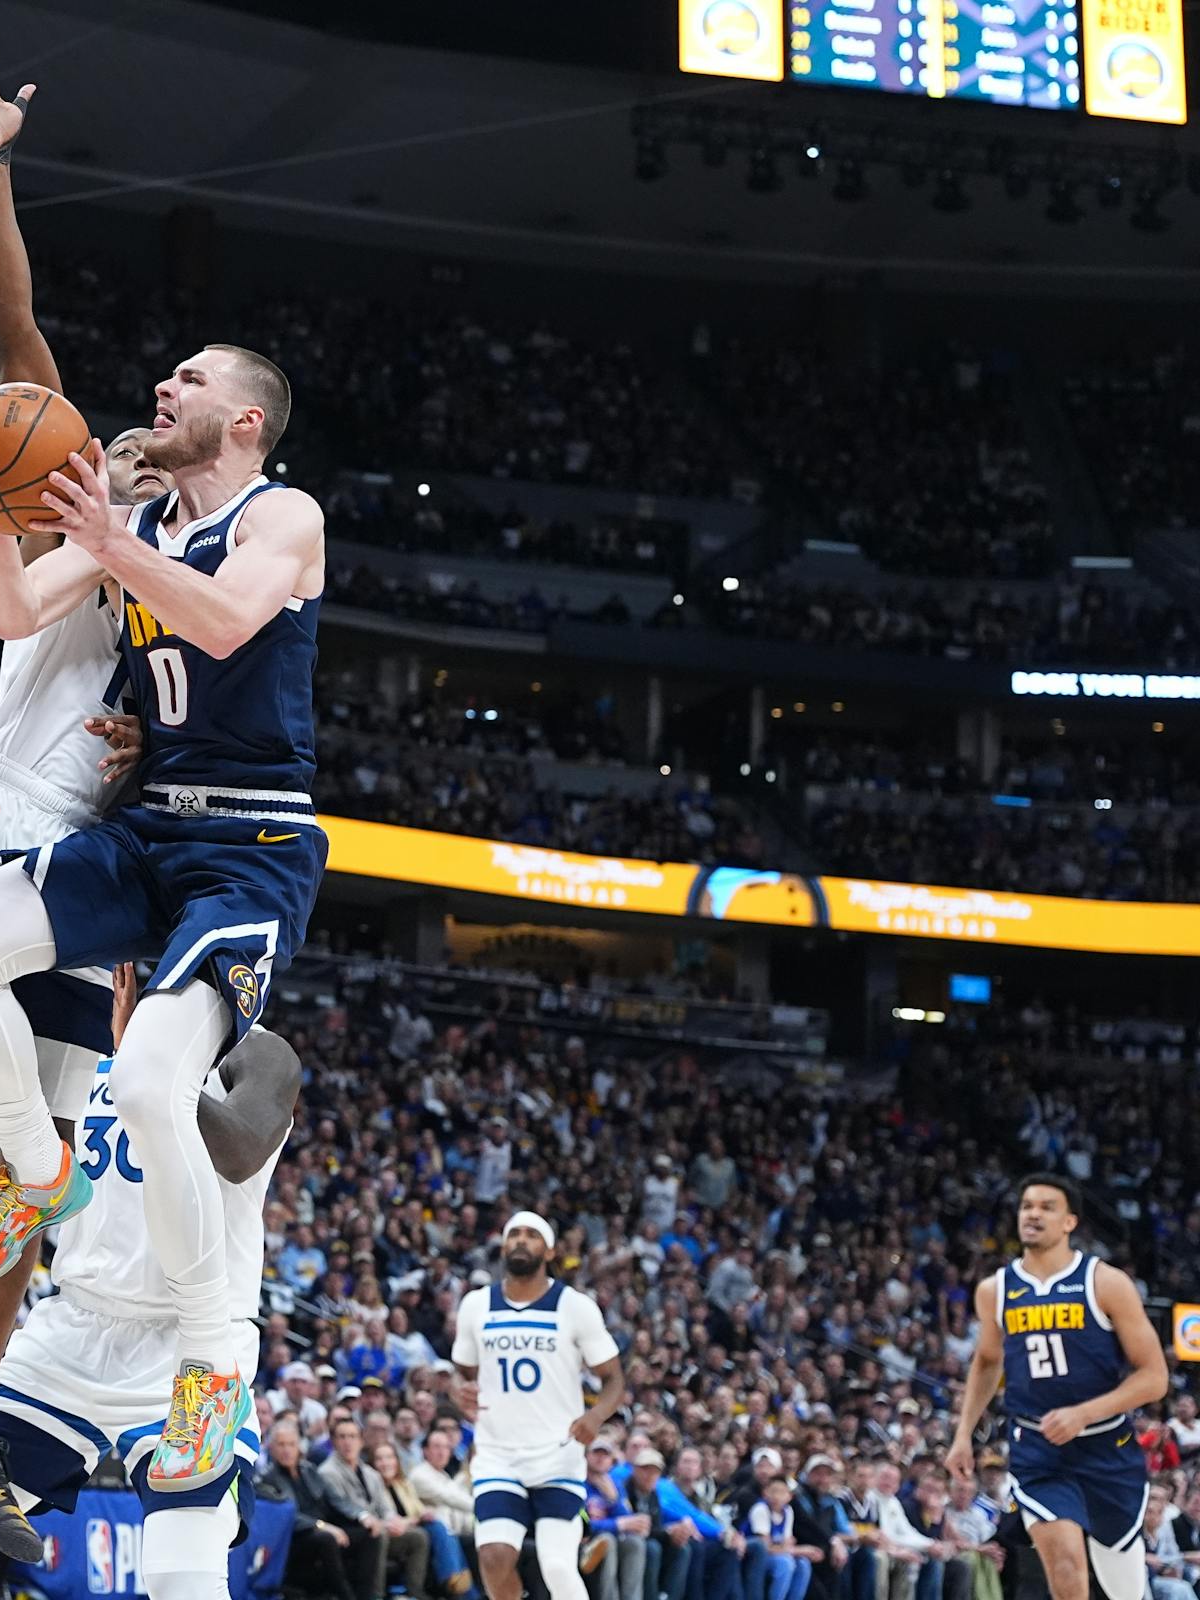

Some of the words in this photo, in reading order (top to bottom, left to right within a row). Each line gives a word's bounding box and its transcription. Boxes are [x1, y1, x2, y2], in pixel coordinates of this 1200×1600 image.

[147, 648, 188, 726] 0
[1005, 1303, 1085, 1335] DENVER
[482, 1335, 557, 1353] WOLVES
[1025, 1333, 1069, 1379] 21
[497, 1357, 542, 1393] 10
